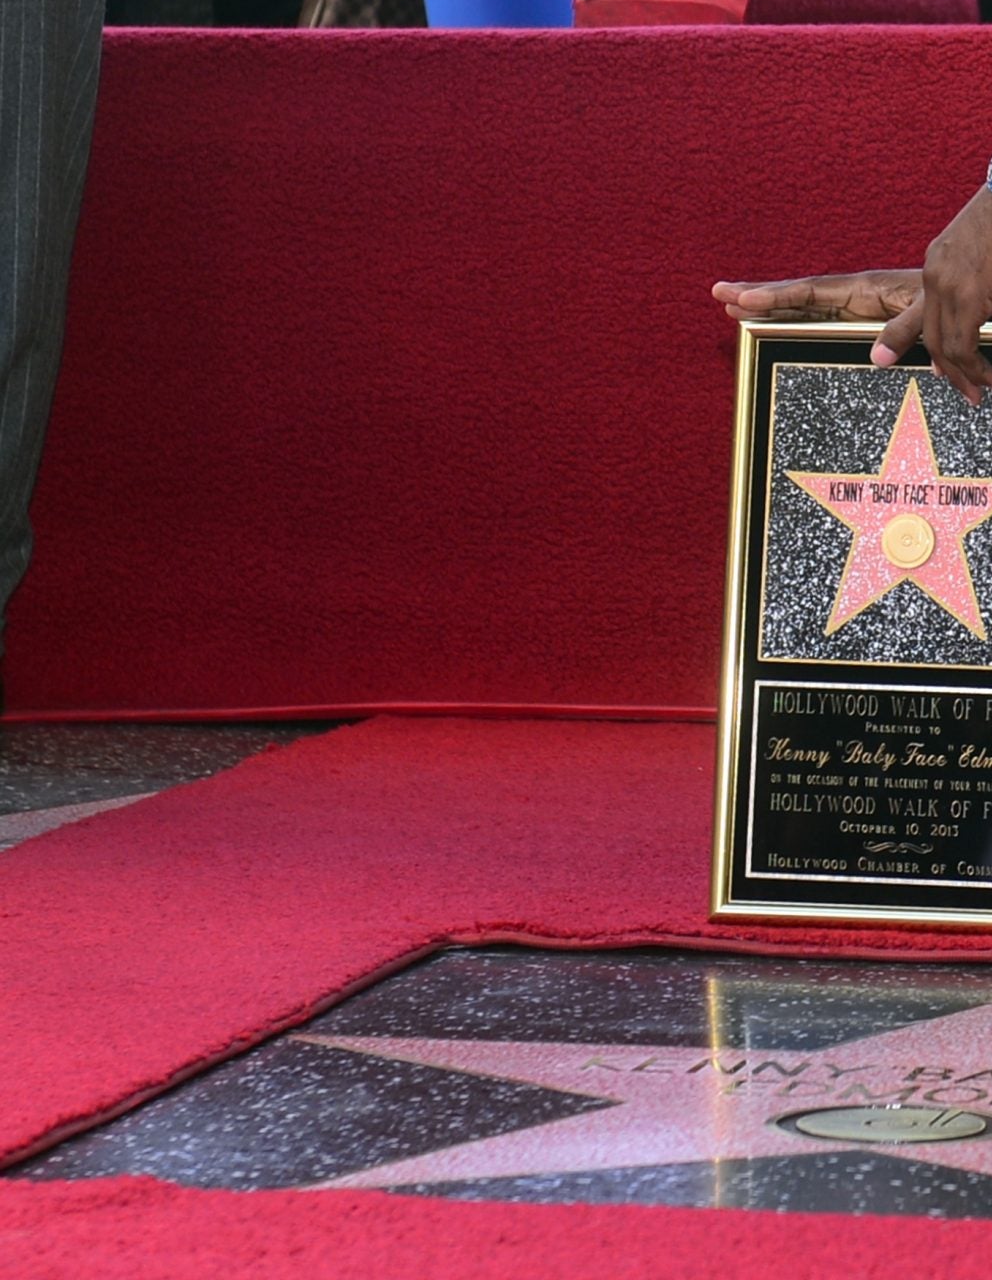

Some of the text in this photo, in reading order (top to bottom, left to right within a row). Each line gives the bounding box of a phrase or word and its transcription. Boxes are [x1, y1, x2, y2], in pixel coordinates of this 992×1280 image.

[829, 482, 863, 502] KENNY
[938, 485, 988, 507] EDMONDS
[773, 691, 878, 716] HOLLYWOOD
[891, 695, 941, 719] WALK
[953, 698, 974, 720] OF
[764, 737, 831, 769] Kenny
[787, 774, 801, 785] THE
[806, 775, 843, 787] OCCASION
[848, 776, 859, 787] OF
[865, 777, 878, 788] THE
[884, 778, 928, 789] PLACEMENT
[933, 780, 943, 790] OF
[950, 781, 971, 792] YOUR
[770, 792, 876, 815] HOLLYWOOD
[888, 797, 938, 818] WALK
[950, 800, 971, 819] OF
[930, 823, 959, 837] 2013
[579, 1057, 881, 1079] KENNY
